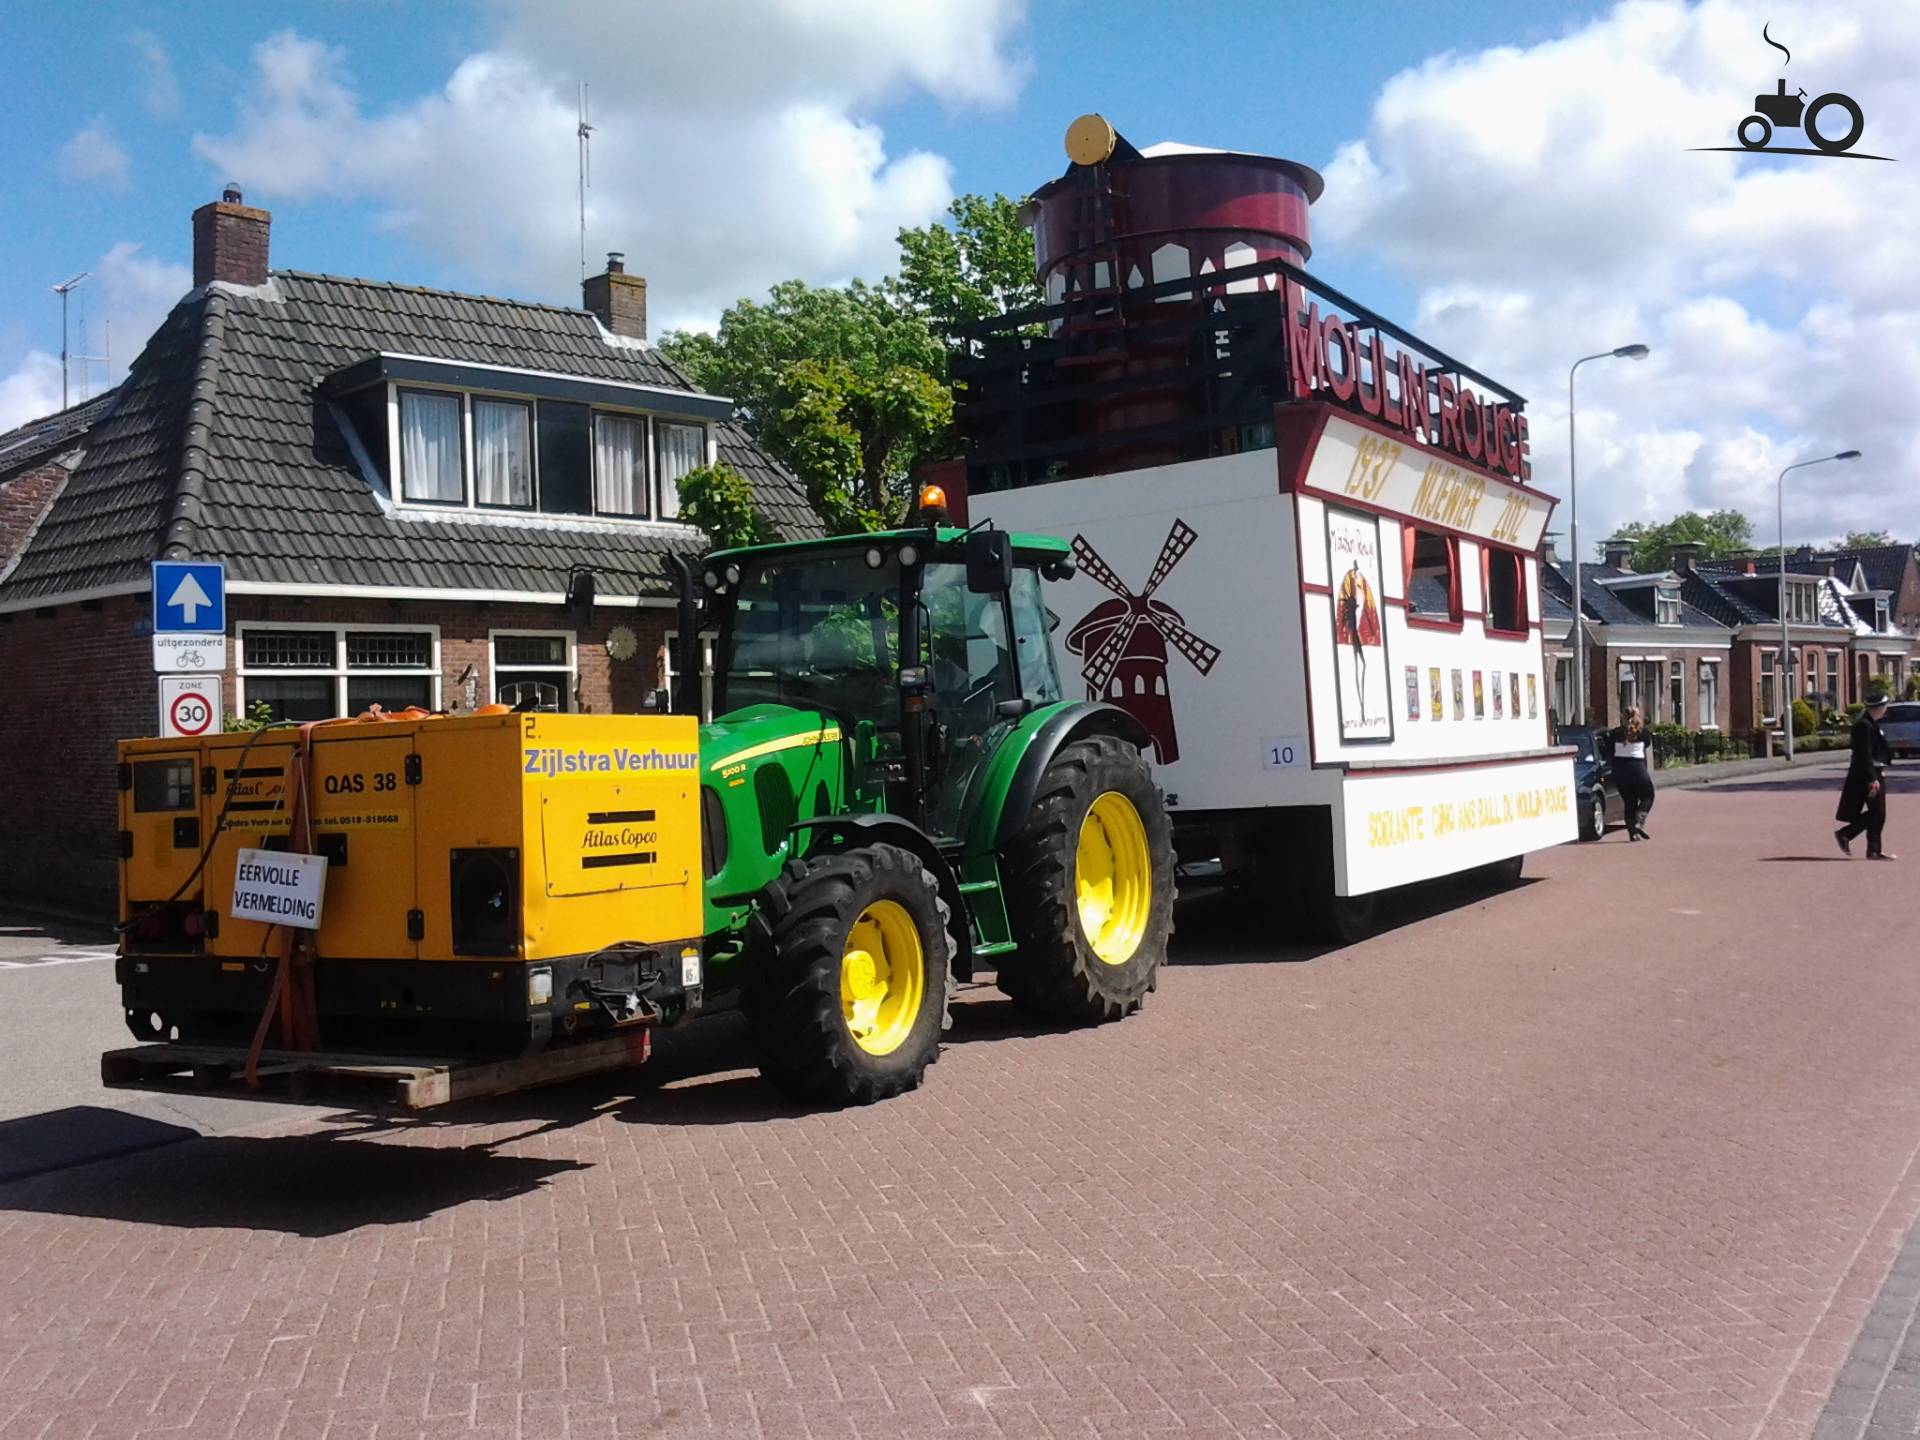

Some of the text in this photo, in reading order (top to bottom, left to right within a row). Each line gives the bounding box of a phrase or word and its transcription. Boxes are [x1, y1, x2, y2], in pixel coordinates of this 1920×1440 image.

[1285, 277, 1531, 481] MOULIN ROUGE
[157, 637, 223, 649] uitgezonderd
[179, 682, 203, 690] ZONE
[178, 705, 205, 722] 30
[524, 748, 698, 777] Zijlstra Verhuur
[1271, 747, 1294, 764] 10
[325, 772, 398, 795] QAS 38
[581, 828, 657, 849] Atlas Copco
[238, 863, 300, 887] EERVOLLE
[234, 890, 316, 920] VERMELDING
